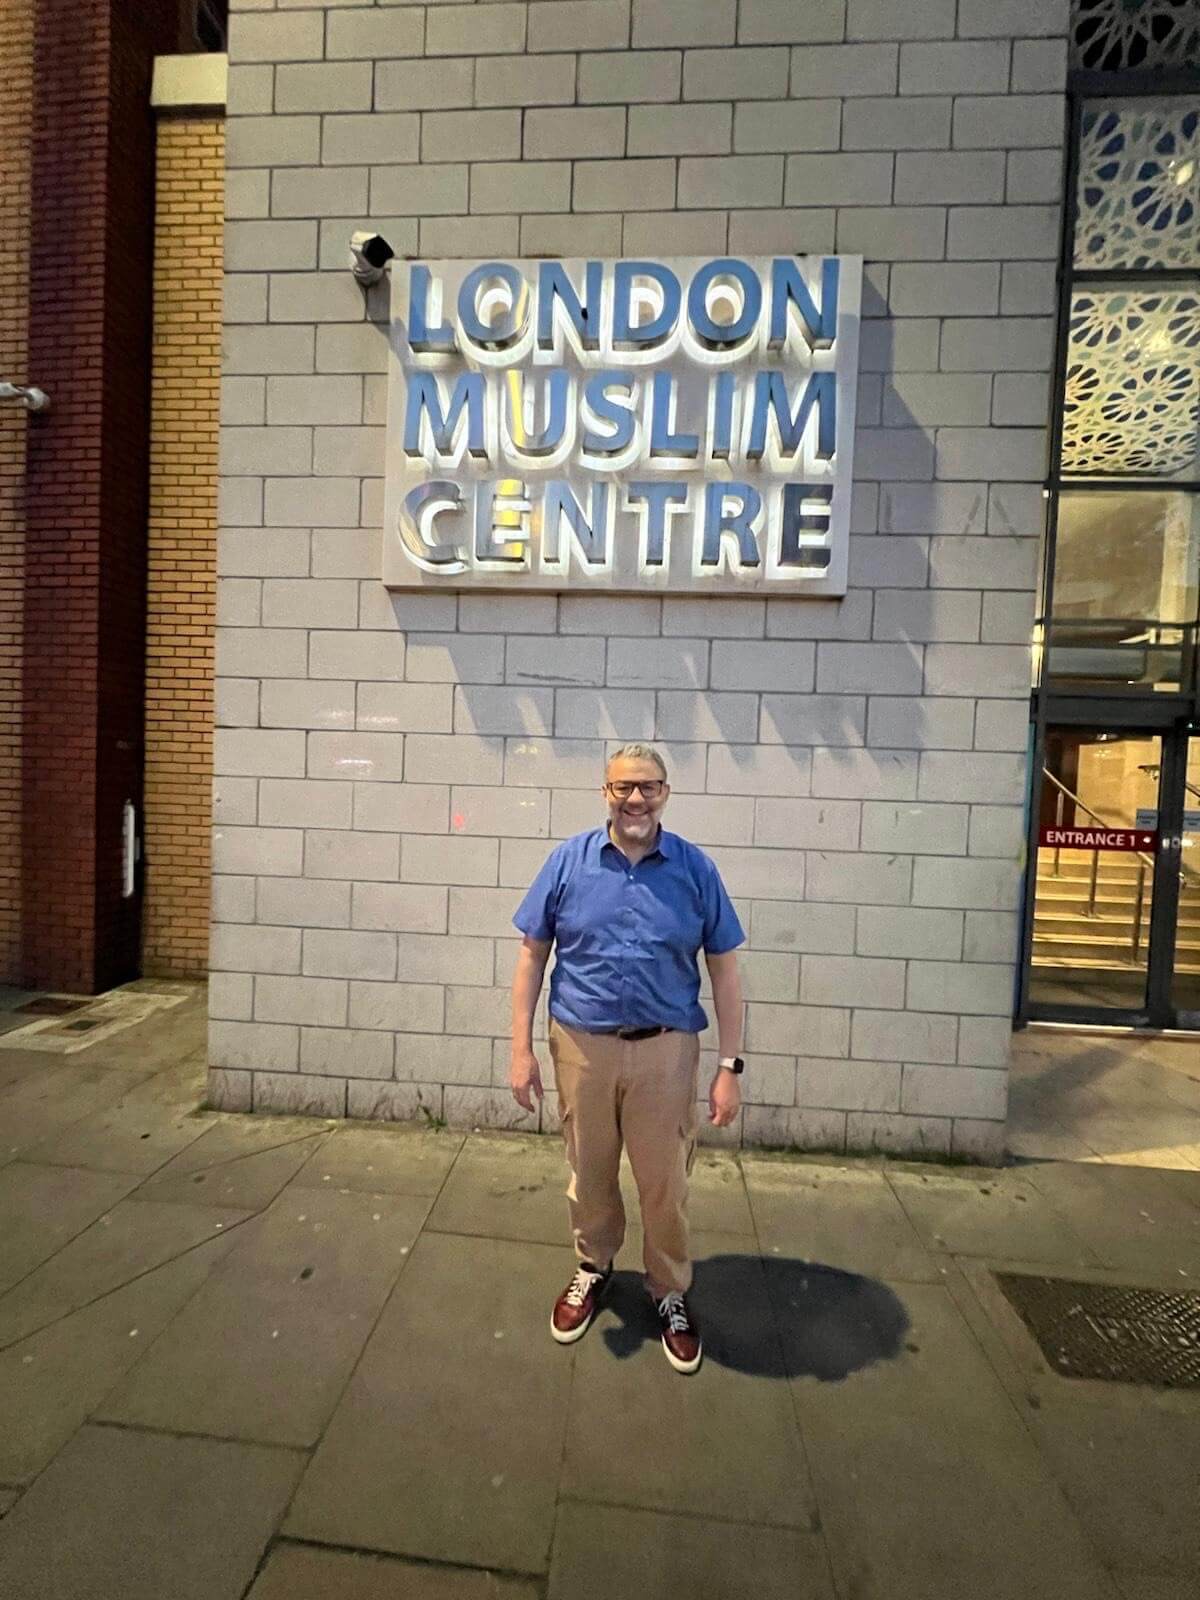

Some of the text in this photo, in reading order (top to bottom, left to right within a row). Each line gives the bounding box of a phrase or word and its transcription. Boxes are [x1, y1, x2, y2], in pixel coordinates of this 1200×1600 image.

[408, 258, 840, 352] LONDON
[403, 370, 837, 460] MUSLIM
[399, 479, 834, 570] CENTRE
[1046, 831, 1136, 847] ENTRANCE 1
